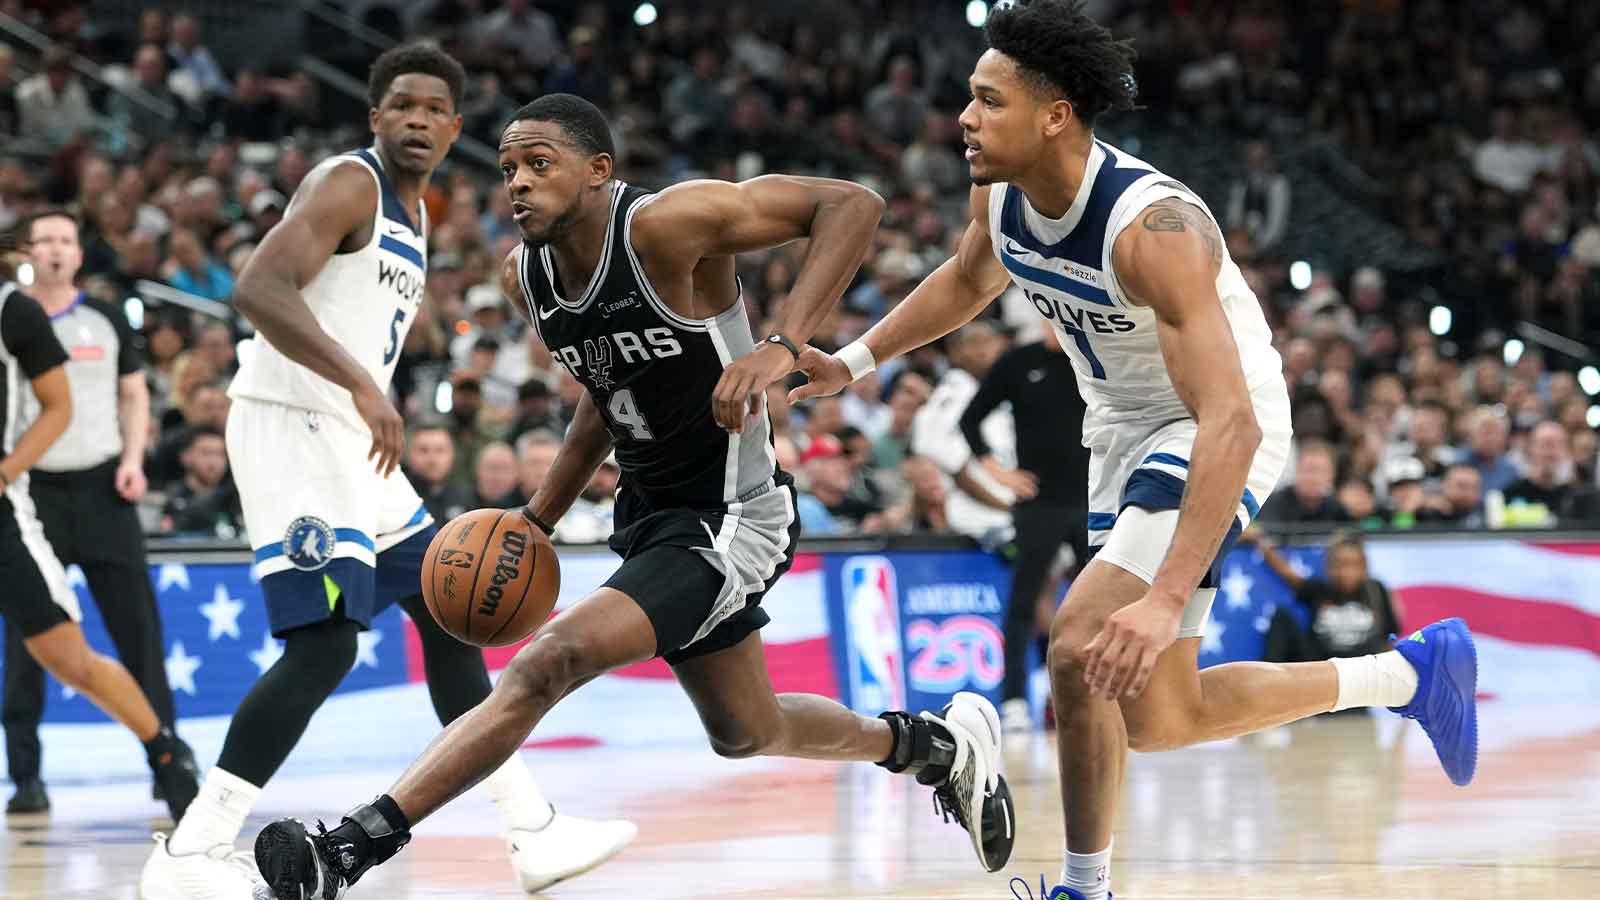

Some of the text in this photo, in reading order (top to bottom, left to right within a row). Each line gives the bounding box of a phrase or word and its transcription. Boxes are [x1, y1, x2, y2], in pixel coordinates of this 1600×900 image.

[1070, 267, 1097, 283] sezzle
[603, 297, 635, 314] LEDGER
[383, 307, 406, 366] 5
[1063, 325, 1107, 380] 1
[607, 388, 655, 441] 4
[478, 530, 527, 617] Wilson
[904, 583, 1002, 615] AMERICA
[905, 615, 1006, 694] 250
